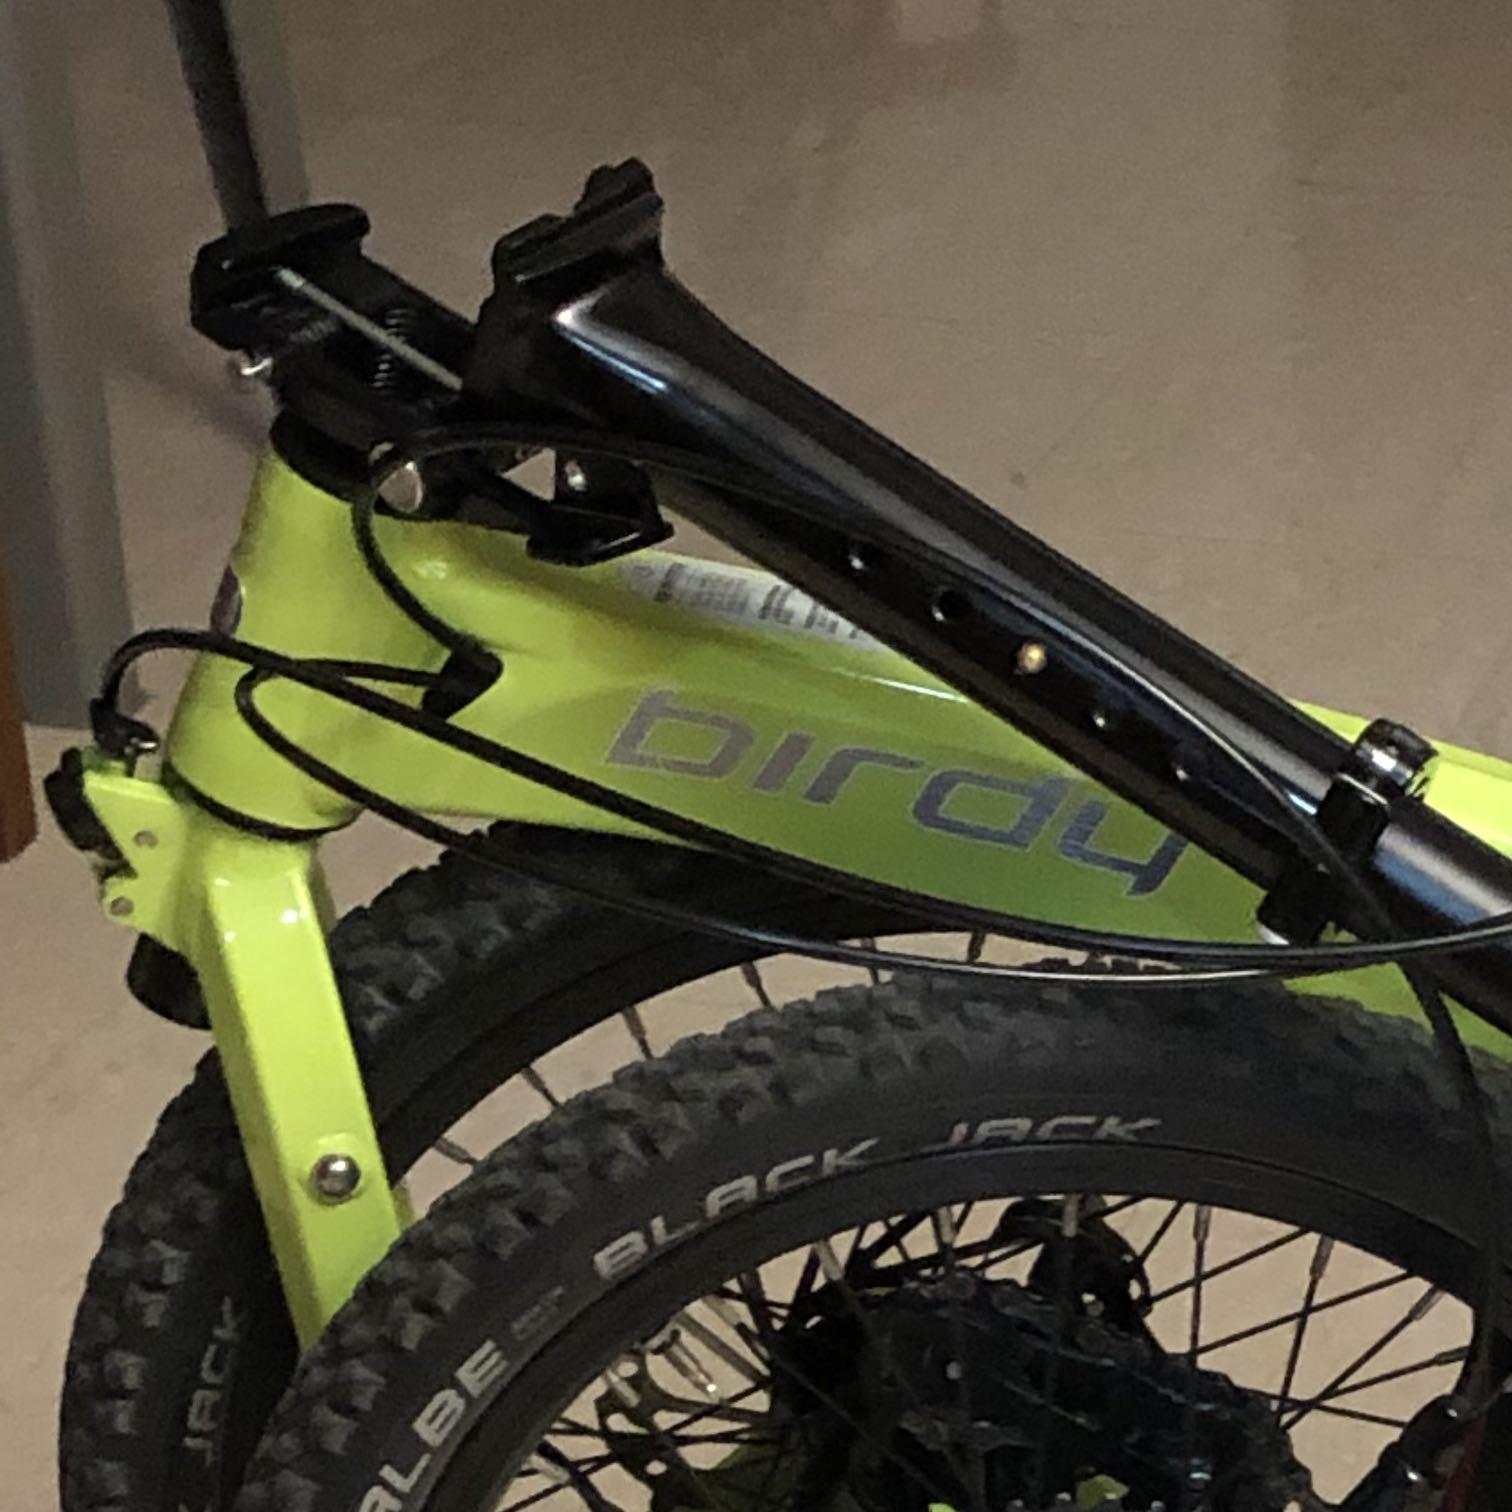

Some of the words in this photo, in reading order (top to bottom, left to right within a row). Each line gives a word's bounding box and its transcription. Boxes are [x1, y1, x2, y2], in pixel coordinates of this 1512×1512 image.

[605, 689, 1190, 895] birdy
[595, 1137, 879, 1280] BLACK
[925, 1115, 1161, 1149] JACK
[184, 1296, 239, 1467] JACK
